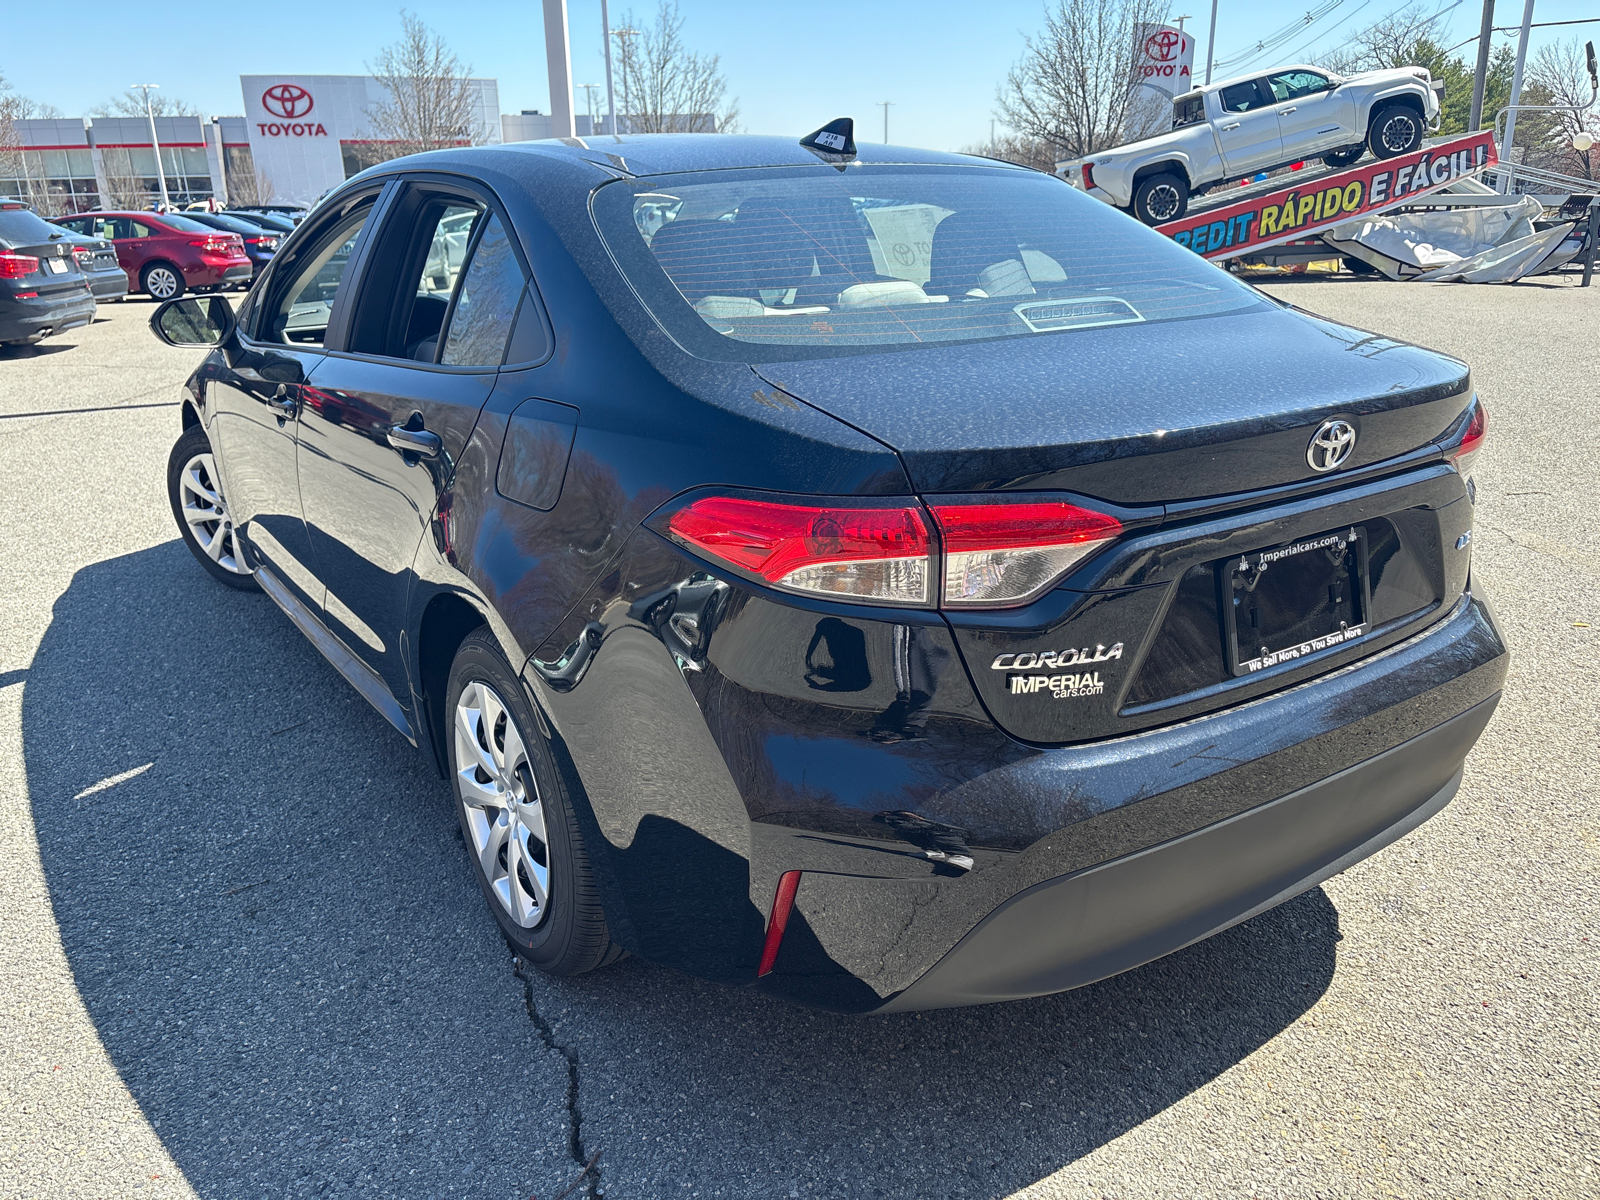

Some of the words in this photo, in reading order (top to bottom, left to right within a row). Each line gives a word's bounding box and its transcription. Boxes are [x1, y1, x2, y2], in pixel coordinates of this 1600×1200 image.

[1136, 64, 1190, 77] TOYOA
[256, 123, 328, 137] TOYOTA
[1173, 211, 1255, 254] REDIT
[1259, 181, 1363, 237] RÁPIDO
[1369, 172, 1389, 204] E
[1395, 145, 1485, 196] FÁCIL!
[1260, 534, 1339, 564] Imperialcars.com
[991, 642, 1124, 670] COROLLA
[1248, 660, 1262, 672] We
[1263, 655, 1278, 668] Sell
[1279, 649, 1300, 662] More,
[1300, 644, 1311, 655] So
[1312, 640, 1326, 651] You
[1326, 634, 1344, 646] Save
[1344, 627, 1362, 640] More
[1009, 671, 1105, 695] IMPERIAL
[1053, 685, 1103, 699] cars.com
